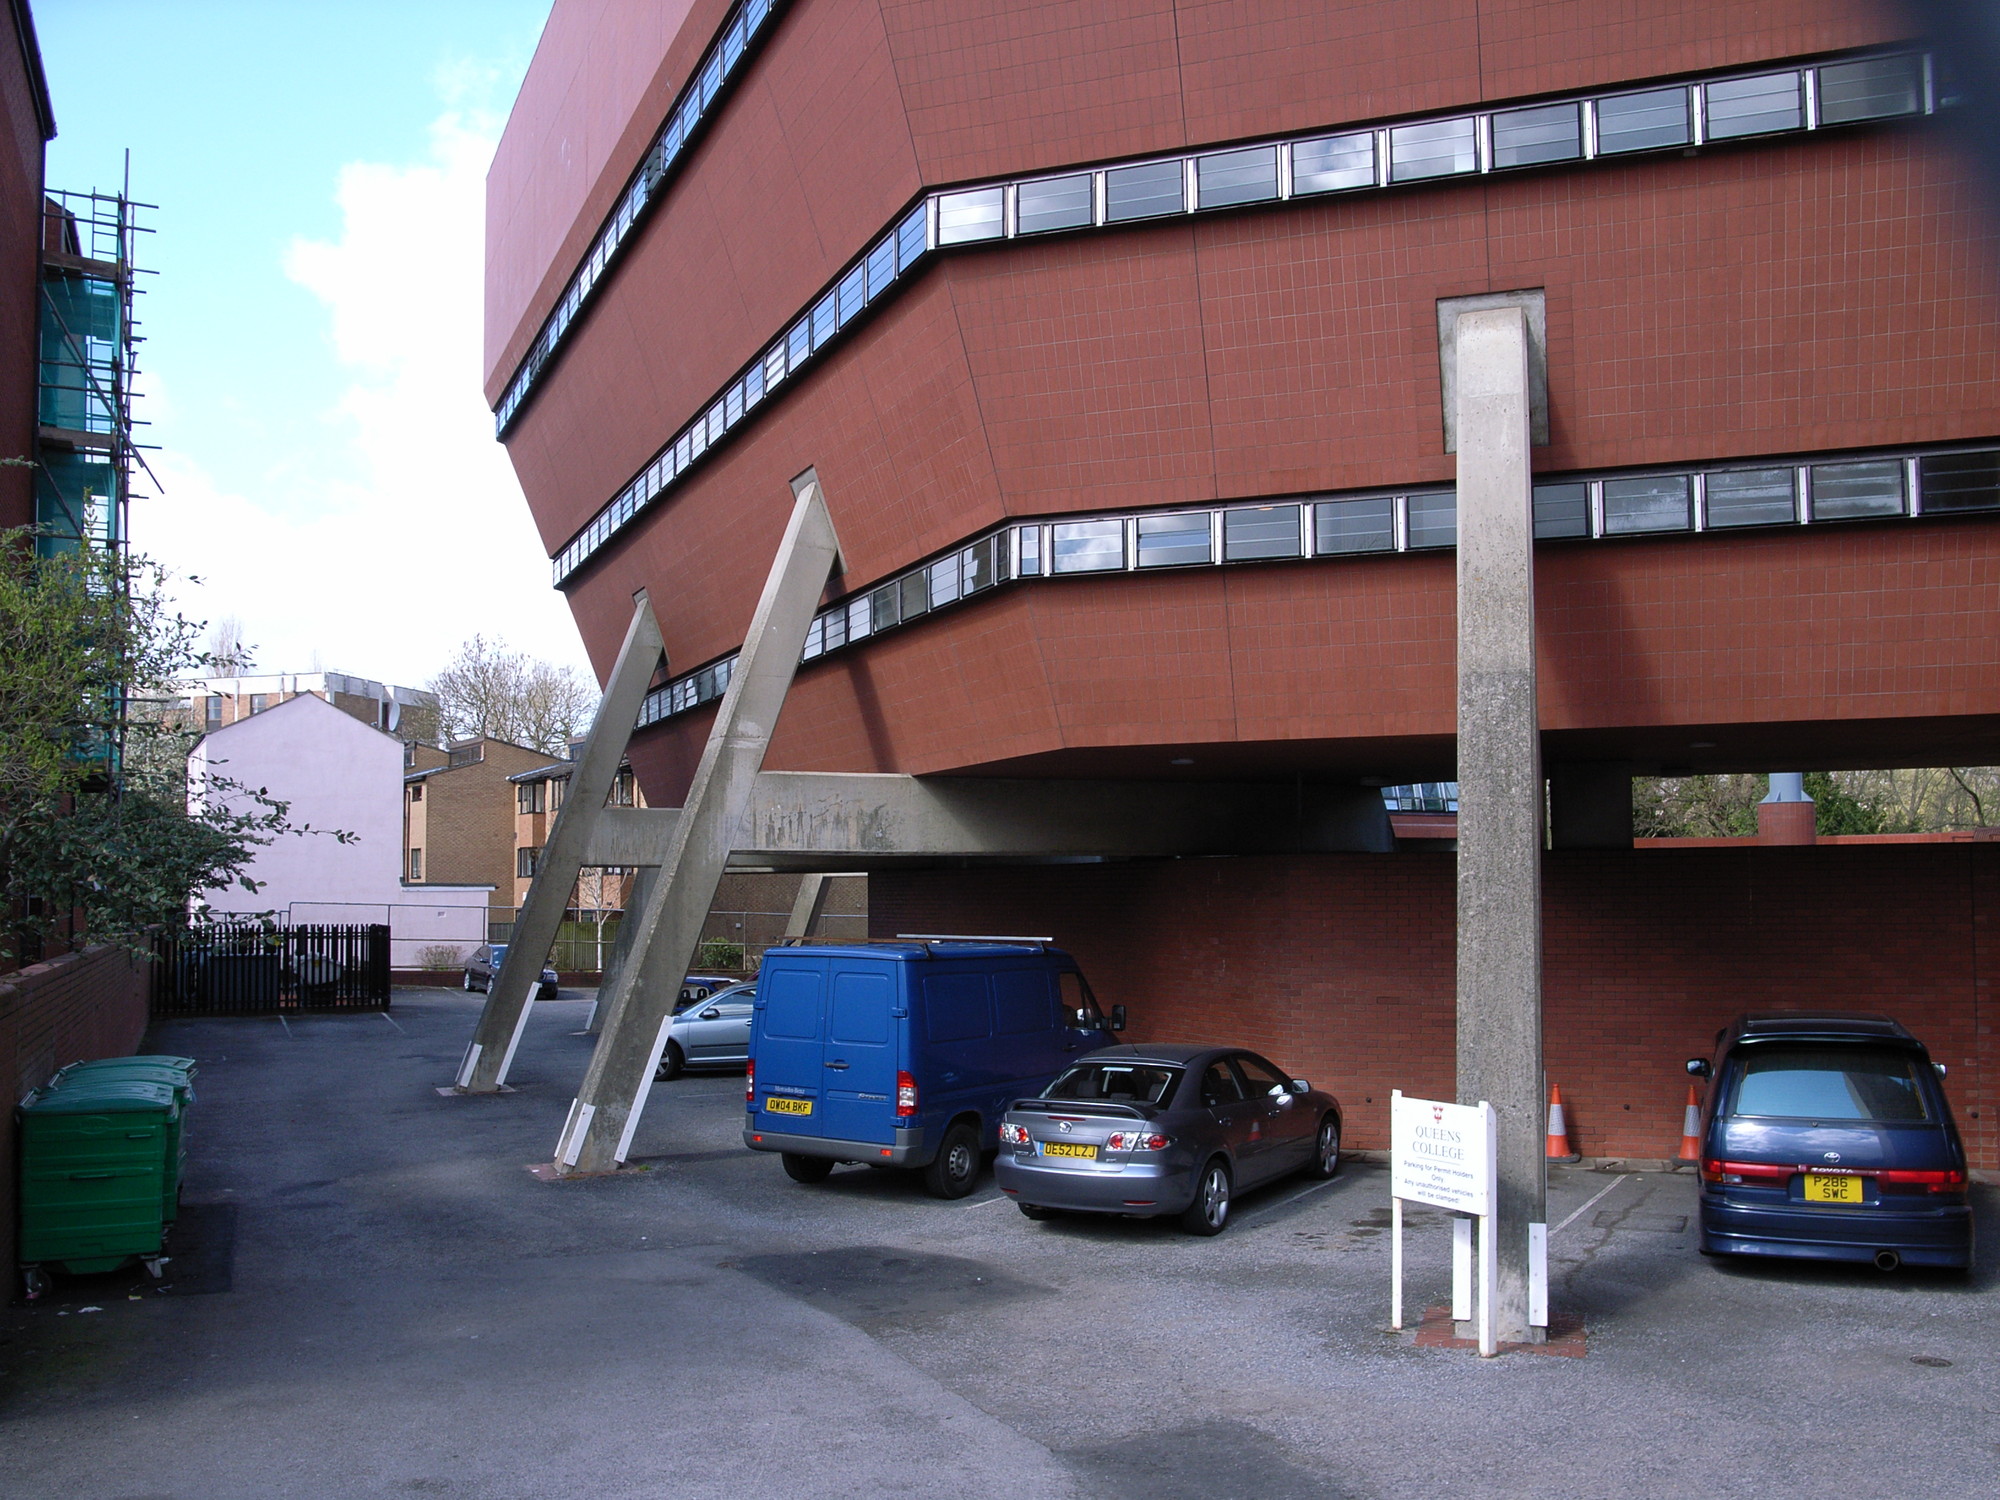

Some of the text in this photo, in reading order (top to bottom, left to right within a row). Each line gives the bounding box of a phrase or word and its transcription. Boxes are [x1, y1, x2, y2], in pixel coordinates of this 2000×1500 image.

[792, 1101, 809, 1112] BKF
[1415, 1125, 1461, 1143] QUEENS
[1045, 1143, 1071, 1156] OE52
[1074, 1145, 1095, 1158] LZJ
[1412, 1141, 1465, 1161] COLLEGE
[1403, 1160, 1424, 1171] Parking
[1433, 1165, 1451, 1175] Permit
[1452, 1169, 1474, 1179] Holders
[1431, 1174, 1444, 1183] Only
[1813, 1176, 1848, 1188] P286
[1404, 1178, 1474, 1198] Any unauthorised vehicles
[1823, 1188, 1848, 1199] SWC
